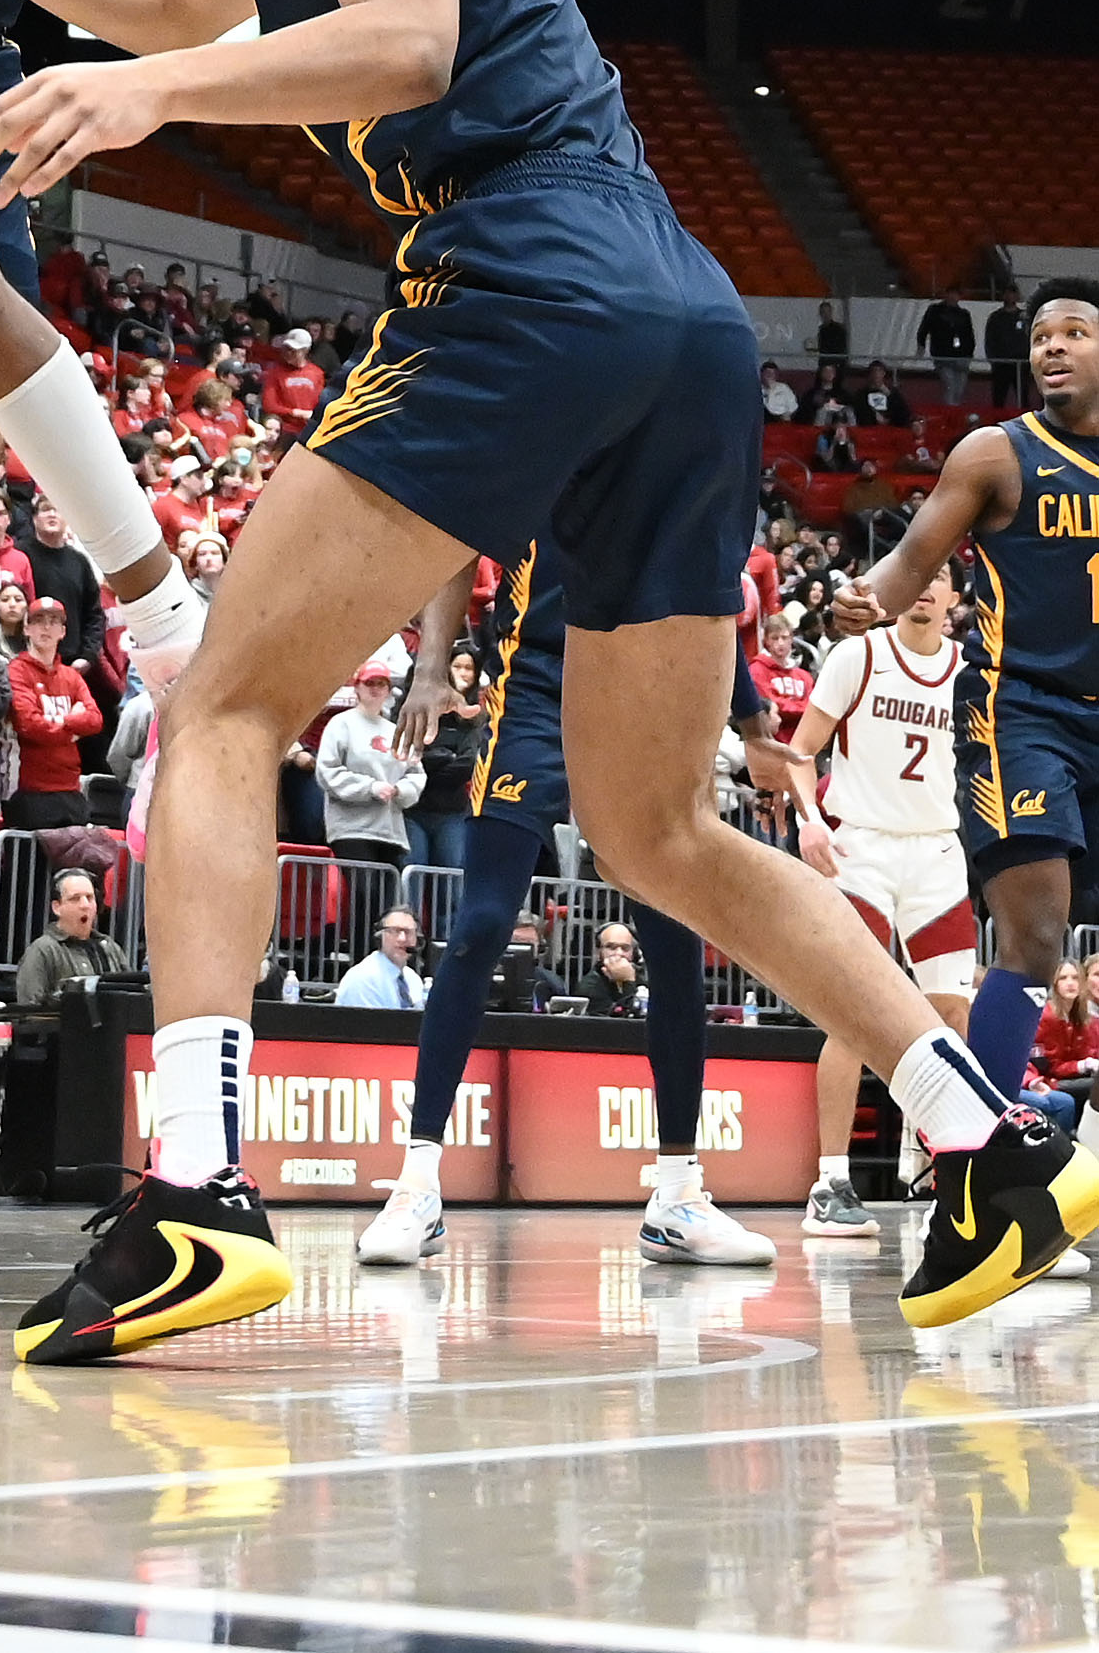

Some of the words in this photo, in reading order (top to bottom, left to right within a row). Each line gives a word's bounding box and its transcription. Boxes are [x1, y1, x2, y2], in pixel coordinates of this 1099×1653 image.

[900, 732, 929, 782] 2
[490, 773, 527, 802] Cal
[1011, 789, 1046, 818] Cal
